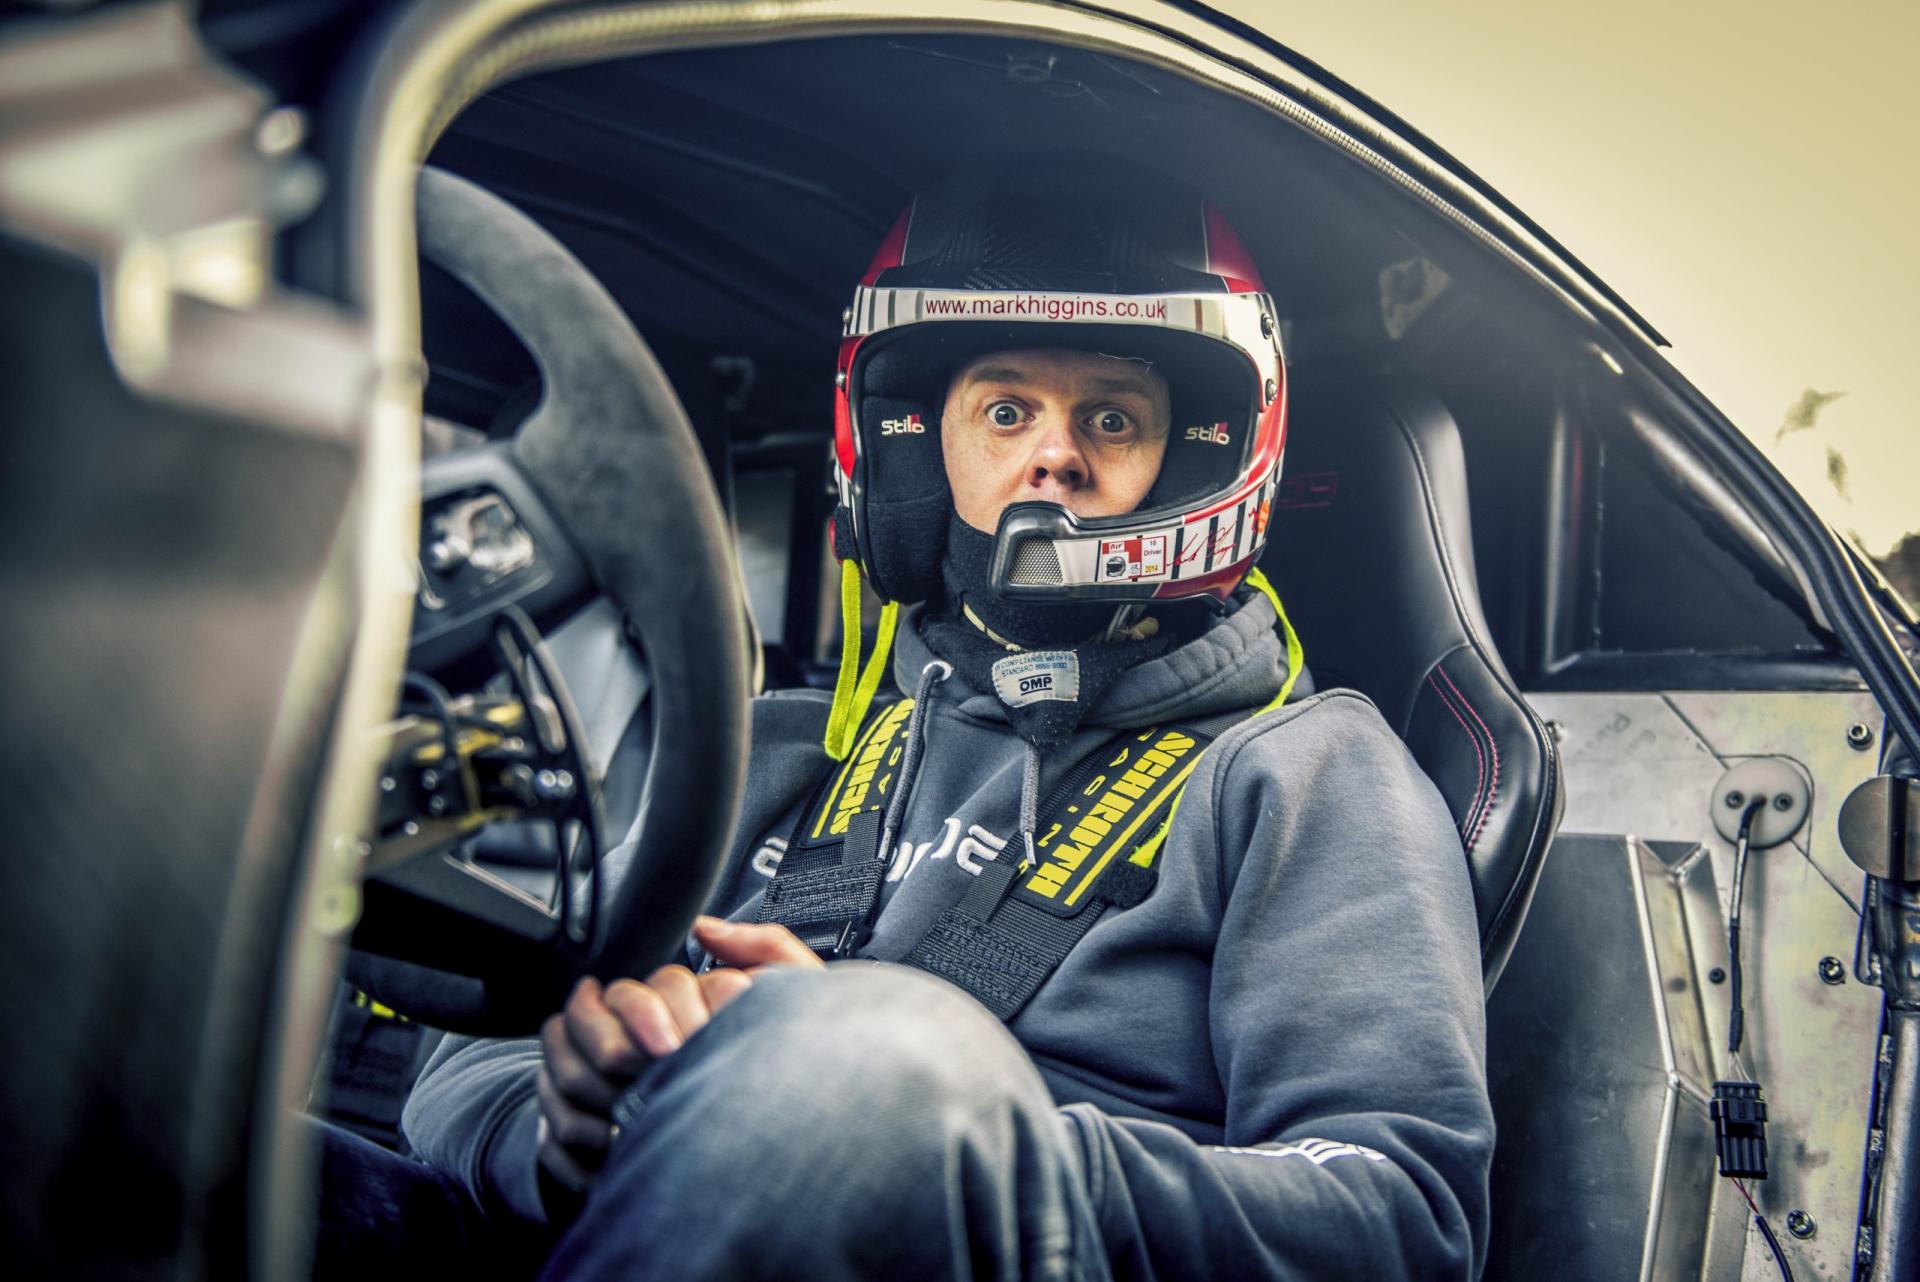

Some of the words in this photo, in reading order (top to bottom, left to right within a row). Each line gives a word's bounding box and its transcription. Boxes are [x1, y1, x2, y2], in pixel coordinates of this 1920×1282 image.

[926, 294, 1167, 321] www.markhiggins.co.uk
[1001, 664, 1034, 677] STANDARD
[1019, 676, 1053, 692] OMP
[1025, 732, 1196, 899] SCHROTH
